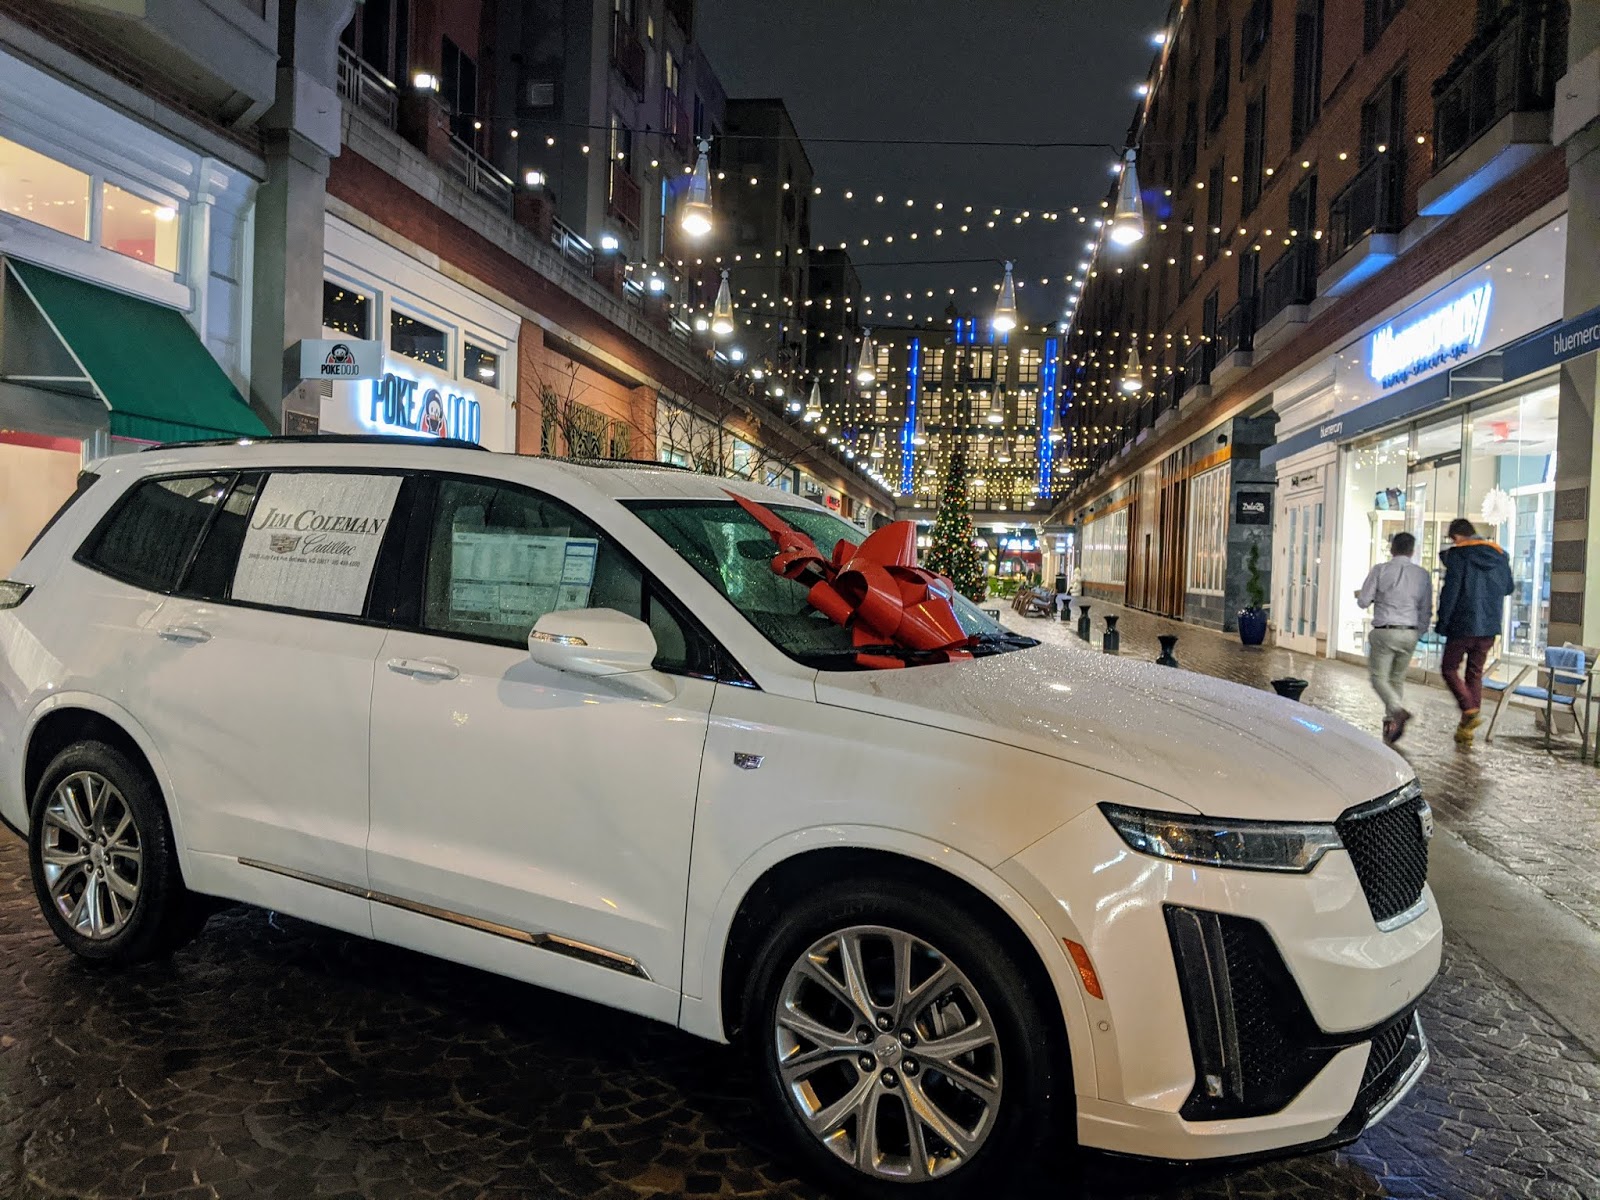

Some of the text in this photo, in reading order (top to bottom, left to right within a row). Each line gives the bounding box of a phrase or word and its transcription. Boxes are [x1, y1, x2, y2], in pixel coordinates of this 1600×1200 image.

[1553, 325, 1600, 355] bluemerc
[320, 364, 360, 375] POKE DOJO
[370, 373, 419, 431] POKE
[252, 508, 386, 534] JIM COLEMAN
[301, 533, 356, 556] Cadillac
